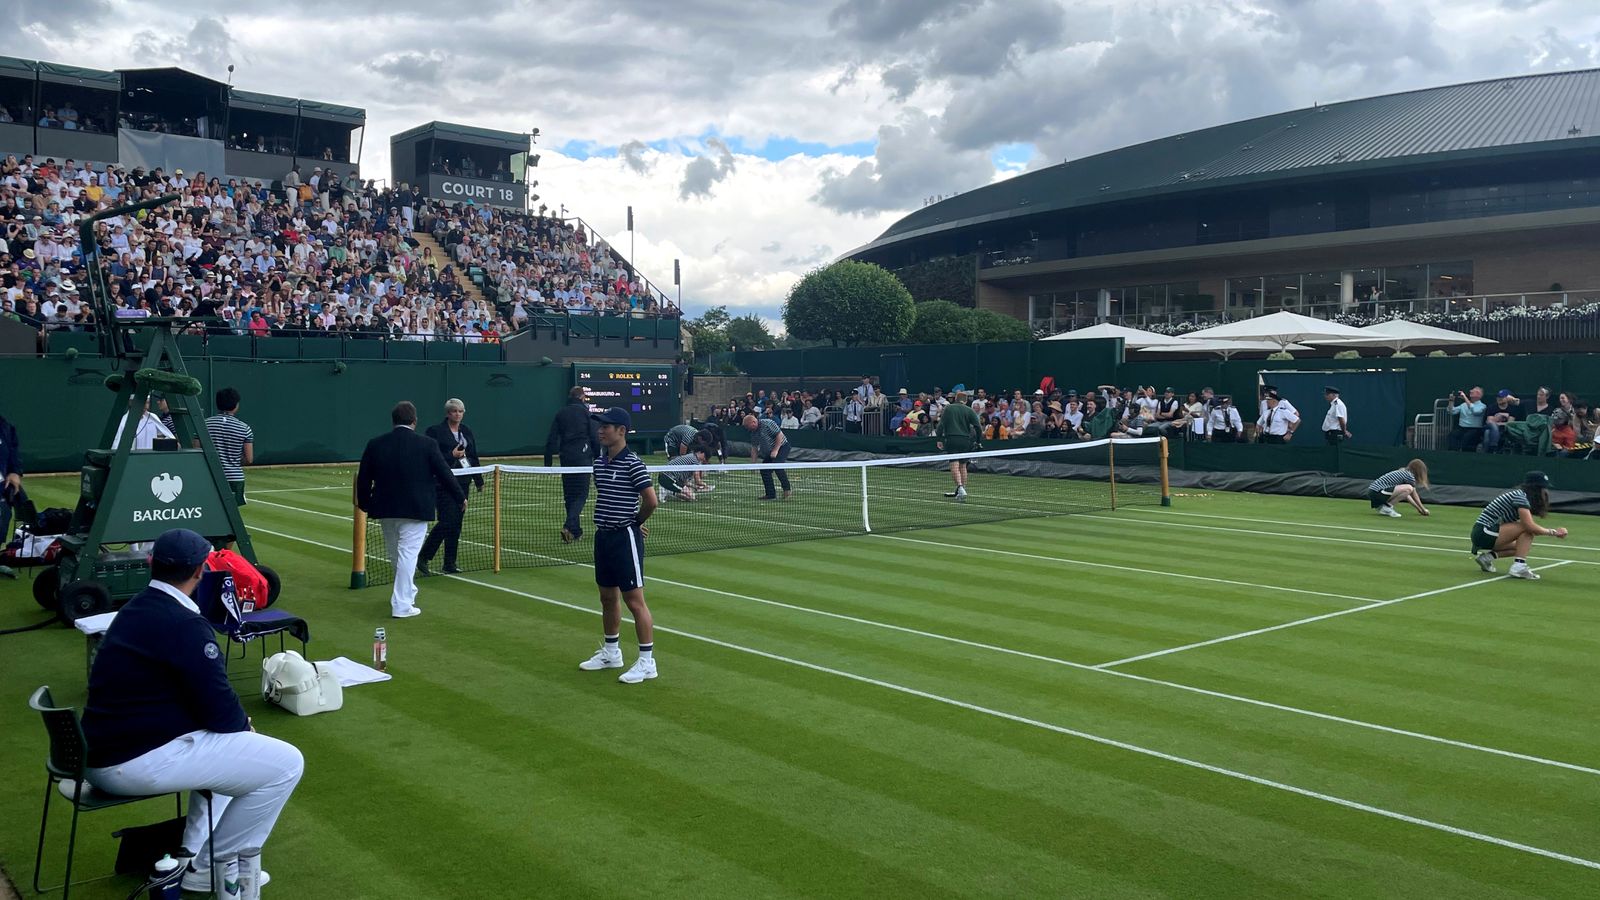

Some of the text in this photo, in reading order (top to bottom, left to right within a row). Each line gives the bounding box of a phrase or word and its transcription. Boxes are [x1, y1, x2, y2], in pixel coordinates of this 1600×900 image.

[442, 182, 514, 201] COURT 18
[133, 507, 202, 522] BARCLAYS
